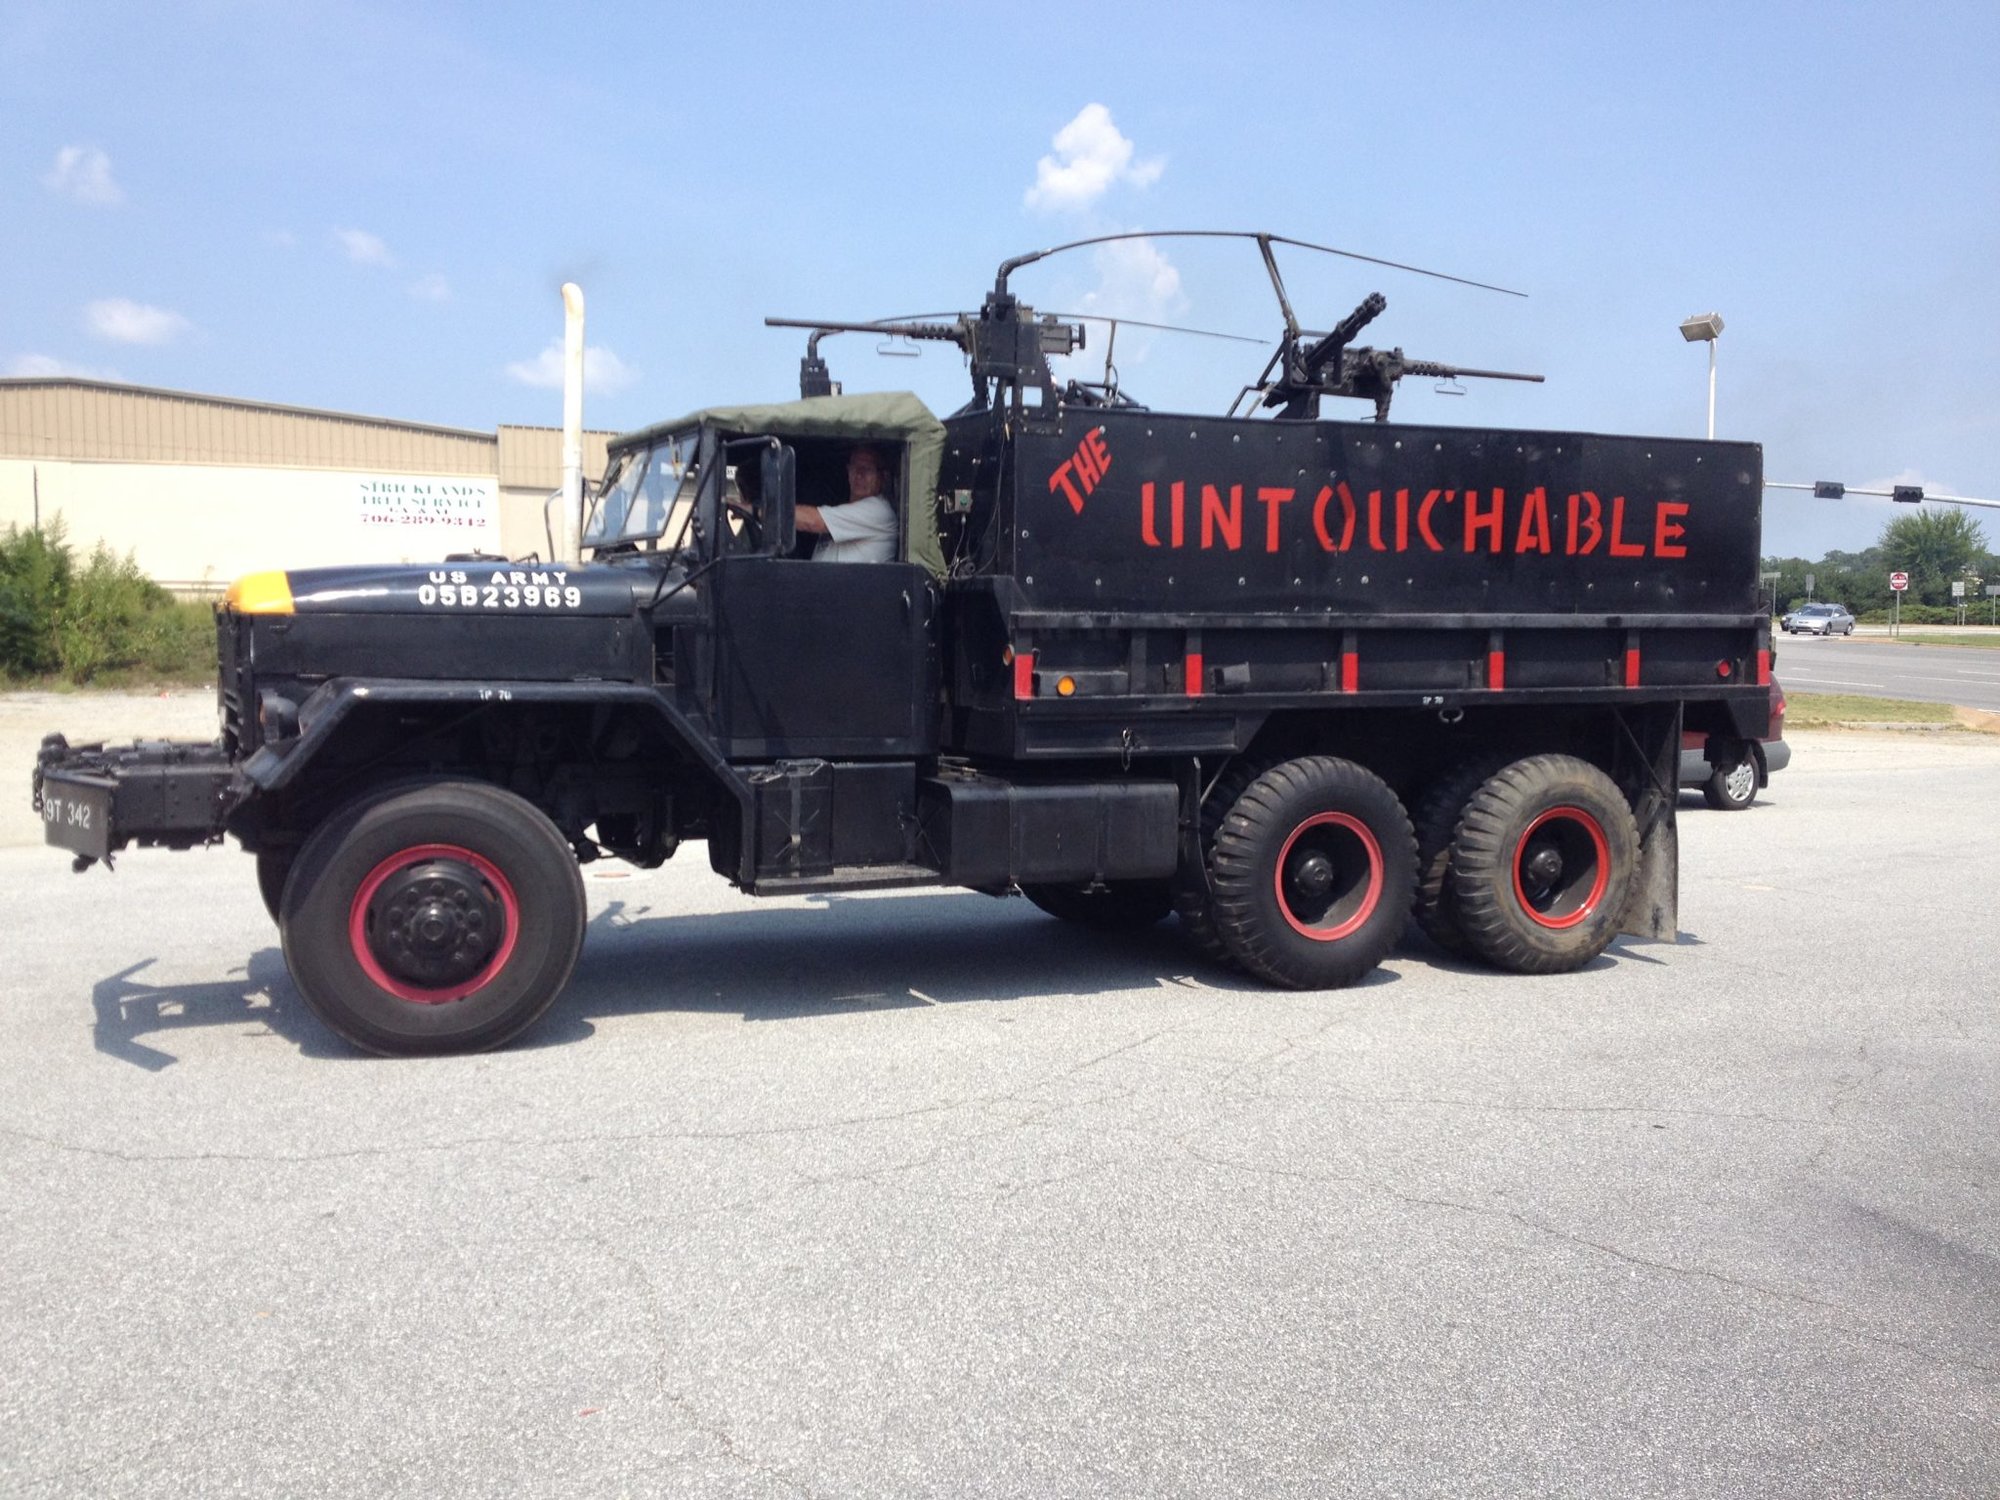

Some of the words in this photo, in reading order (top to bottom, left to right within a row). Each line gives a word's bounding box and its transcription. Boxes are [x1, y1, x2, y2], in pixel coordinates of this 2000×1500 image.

[1049, 427, 1112, 515] THE
[430, 571, 467, 584] US
[491, 571, 567, 585] ARMY
[418, 584, 581, 608] 05B23969
[67, 801, 90, 829] 342
